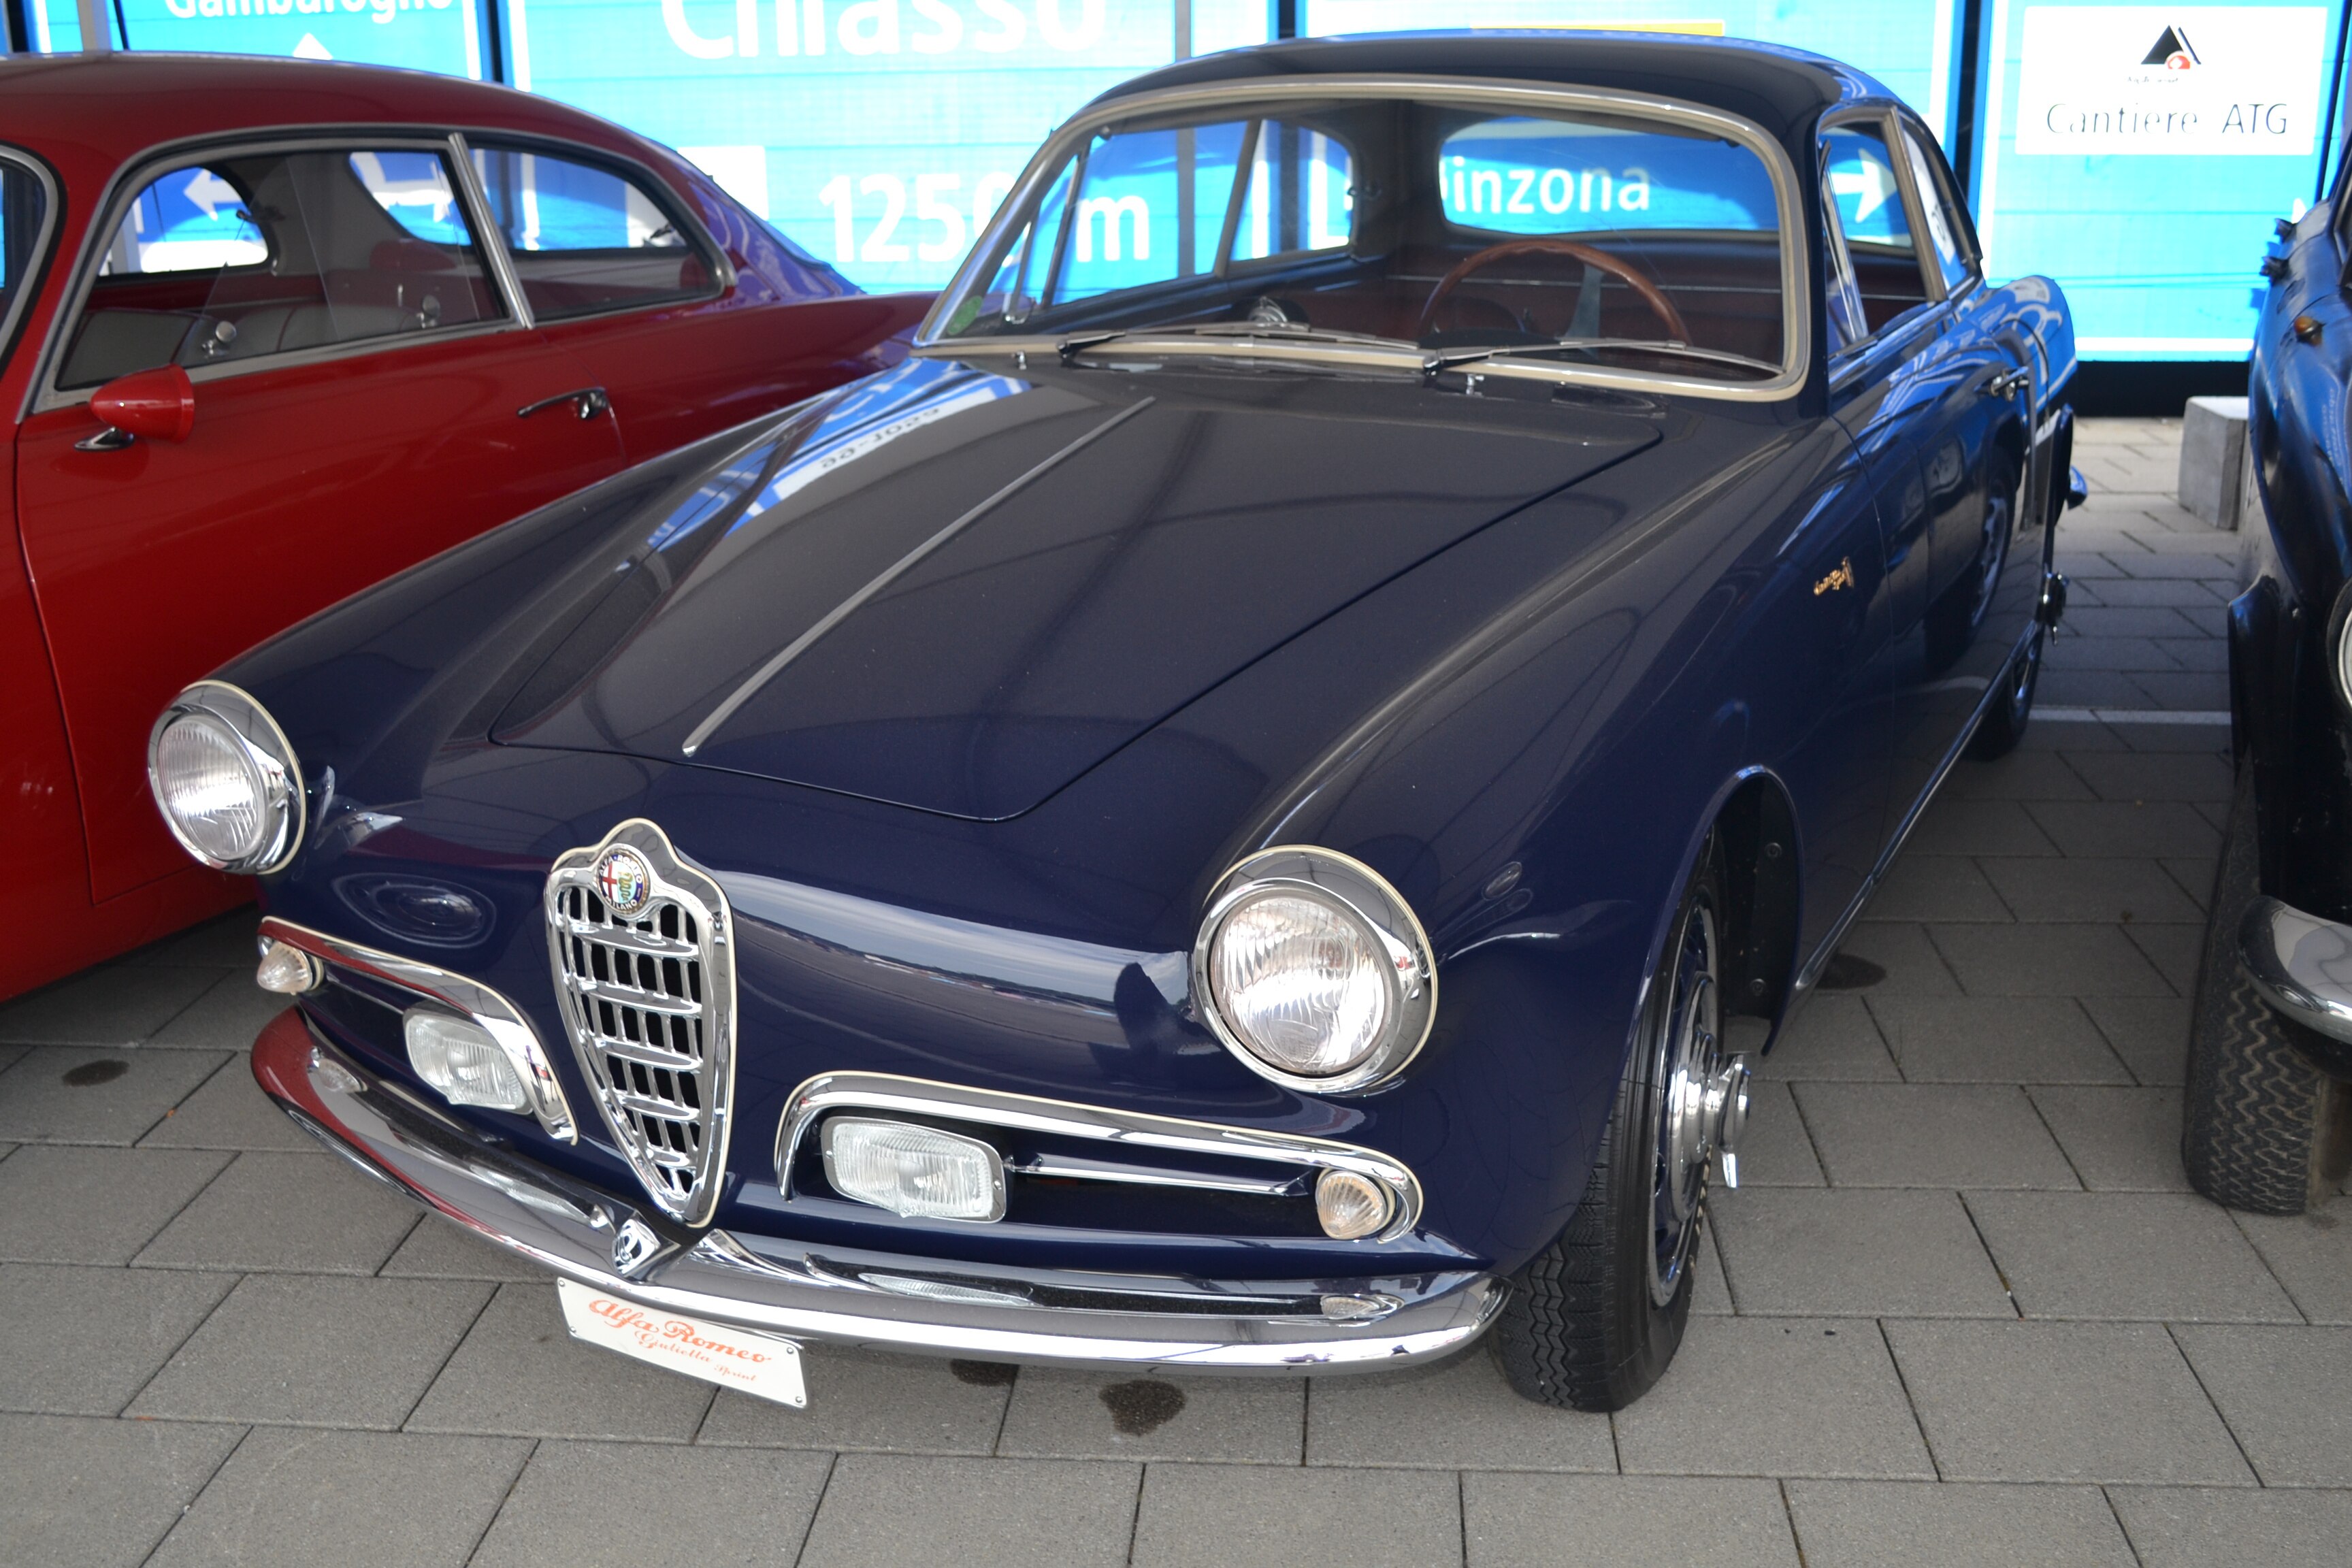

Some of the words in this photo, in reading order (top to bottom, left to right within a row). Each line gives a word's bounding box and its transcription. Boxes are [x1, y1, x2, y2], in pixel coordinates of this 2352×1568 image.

[2046, 102, 2198, 134] Cantiere
[2221, 103, 2287, 135] ATG
[1076, 195, 1149, 263] m
[588, 1298, 659, 1333] Alfa
[662, 1320, 772, 1362] Romeo
